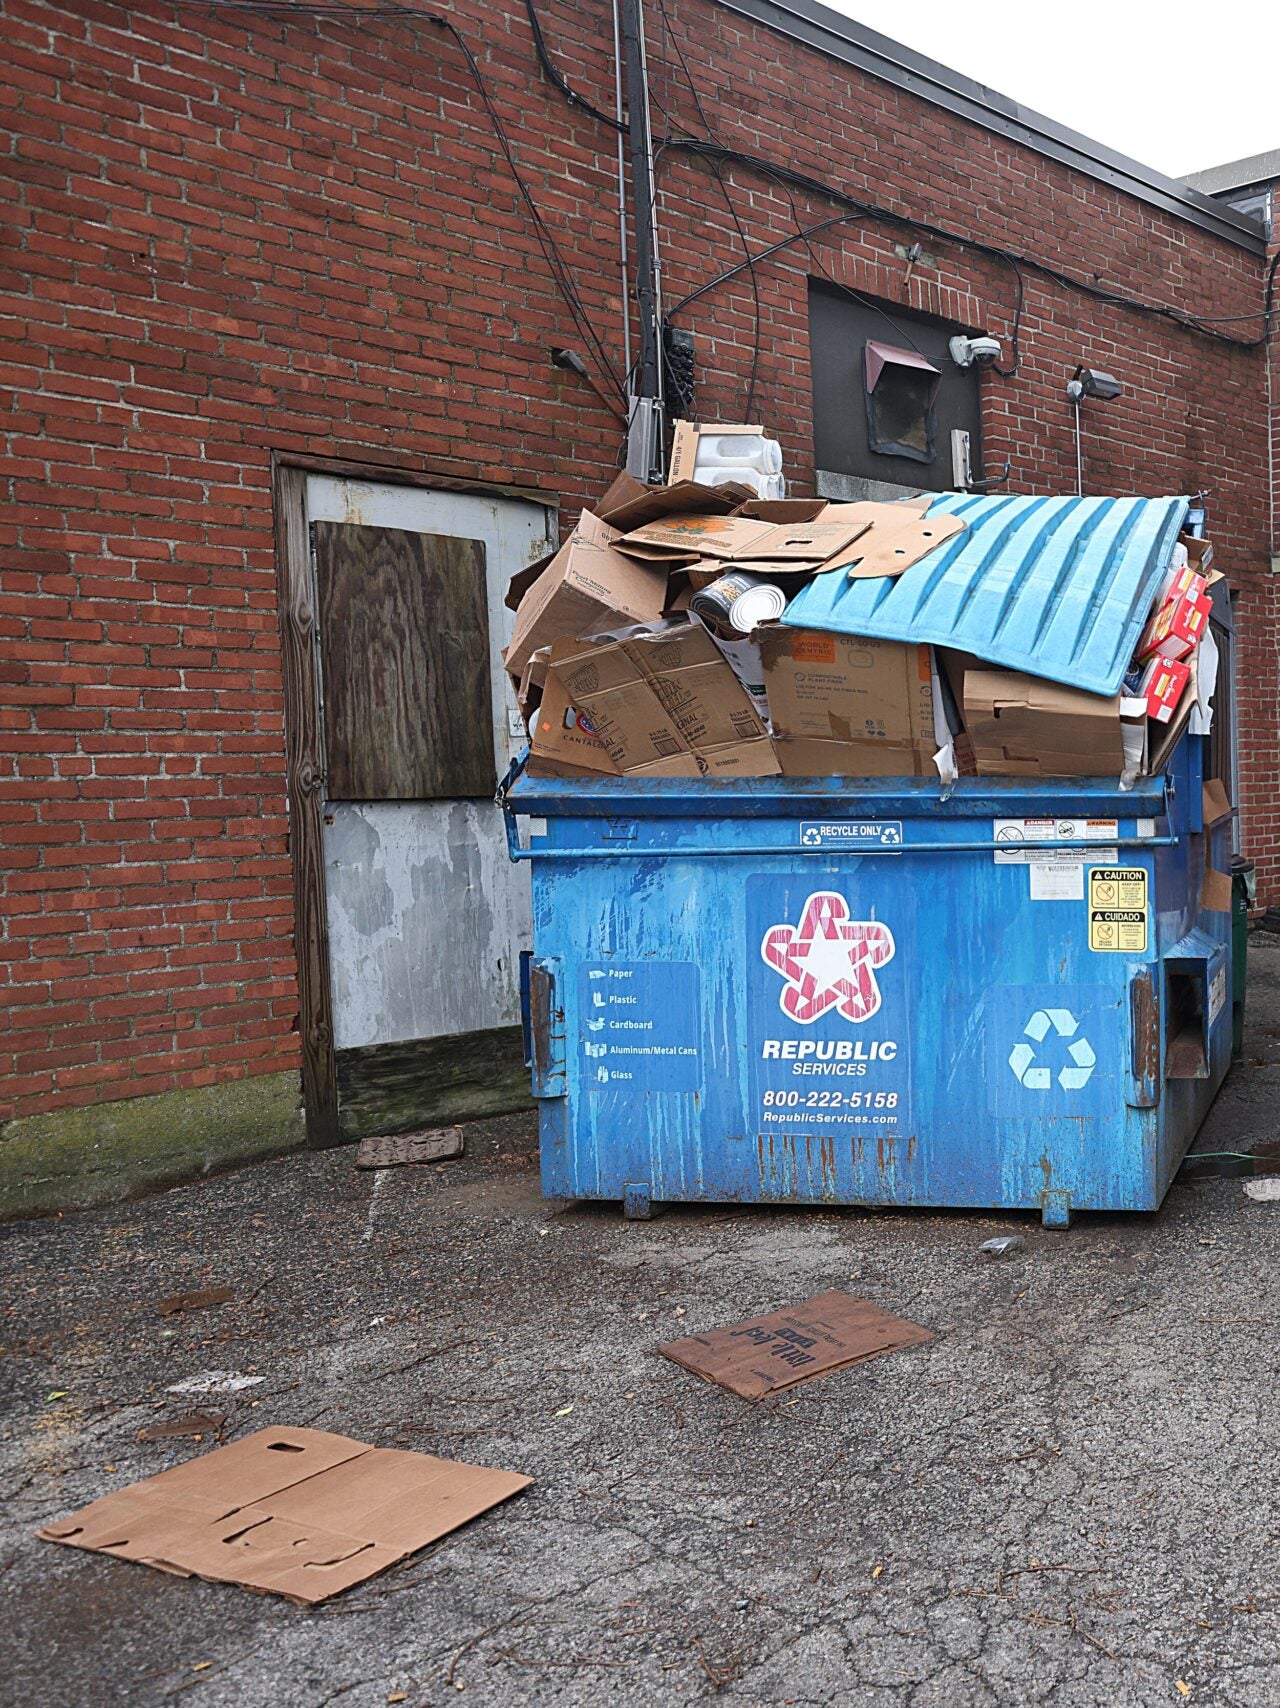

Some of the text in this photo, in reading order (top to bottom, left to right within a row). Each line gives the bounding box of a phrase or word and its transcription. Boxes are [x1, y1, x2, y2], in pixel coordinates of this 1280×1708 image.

[672, 455, 682, 476] GALLON
[798, 641, 830, 649] WORLD
[795, 647, 833, 656] CENTRIC
[820, 826, 882, 836] RECYCLE ONLY
[1104, 872, 1142, 880] CAUTION
[1104, 913, 1140, 921] CUIDADO
[609, 969, 633, 980] Paper
[609, 995, 637, 1004] Plastic
[610, 1020, 653, 1029] Cardboard
[610, 1046, 697, 1055] Aluminum/Metal Cans
[762, 1040, 897, 1060] REPUBLIC
[792, 1063, 867, 1076] SERVICES
[611, 1071, 633, 1079] Glass
[763, 1090, 898, 1108] 800-222-5158
[763, 1112, 897, 1124] RepublicServices.com
